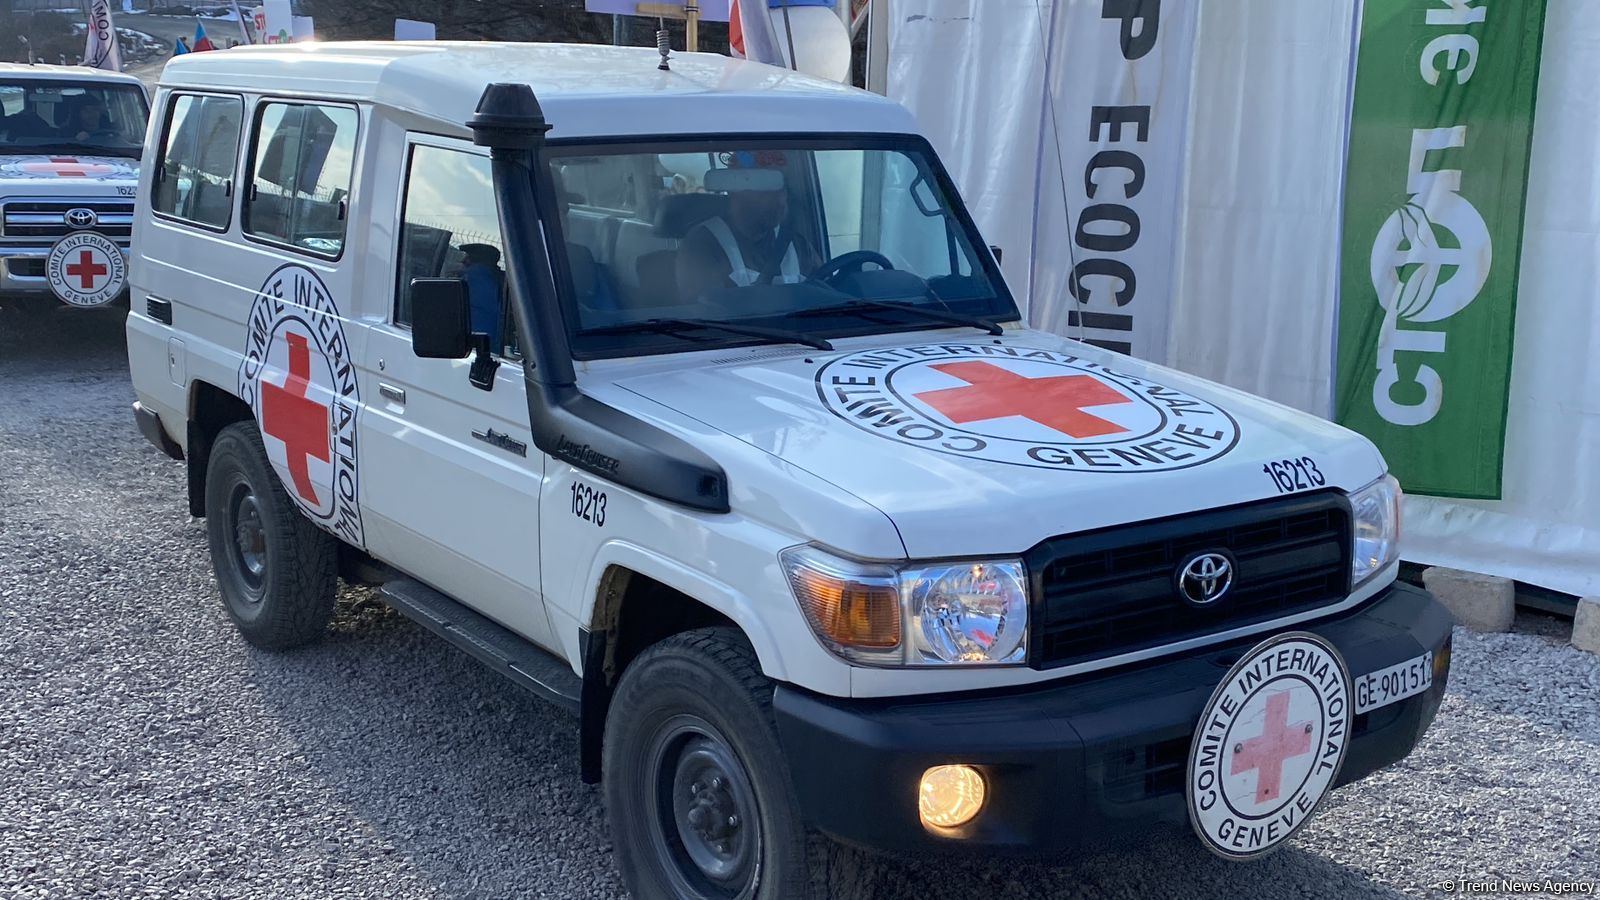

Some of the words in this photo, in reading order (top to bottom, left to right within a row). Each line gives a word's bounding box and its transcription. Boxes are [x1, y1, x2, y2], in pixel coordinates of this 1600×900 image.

[51, 247, 66, 286] COMITE
[65, 236, 123, 285] INTERNATIONAL
[64, 289, 112, 304] GENEVE
[241, 279, 285, 408] COMITE
[832, 375, 987, 453] COMITE
[1027, 423, 1223, 467] GENEVE
[1263, 457, 1325, 493] 16213
[571, 481, 607, 527] 16213
[1199, 694, 1238, 811] COMITE
[1238, 648, 1344, 776] INTERNATIONAL
[1218, 791, 1313, 847] GENEVE
